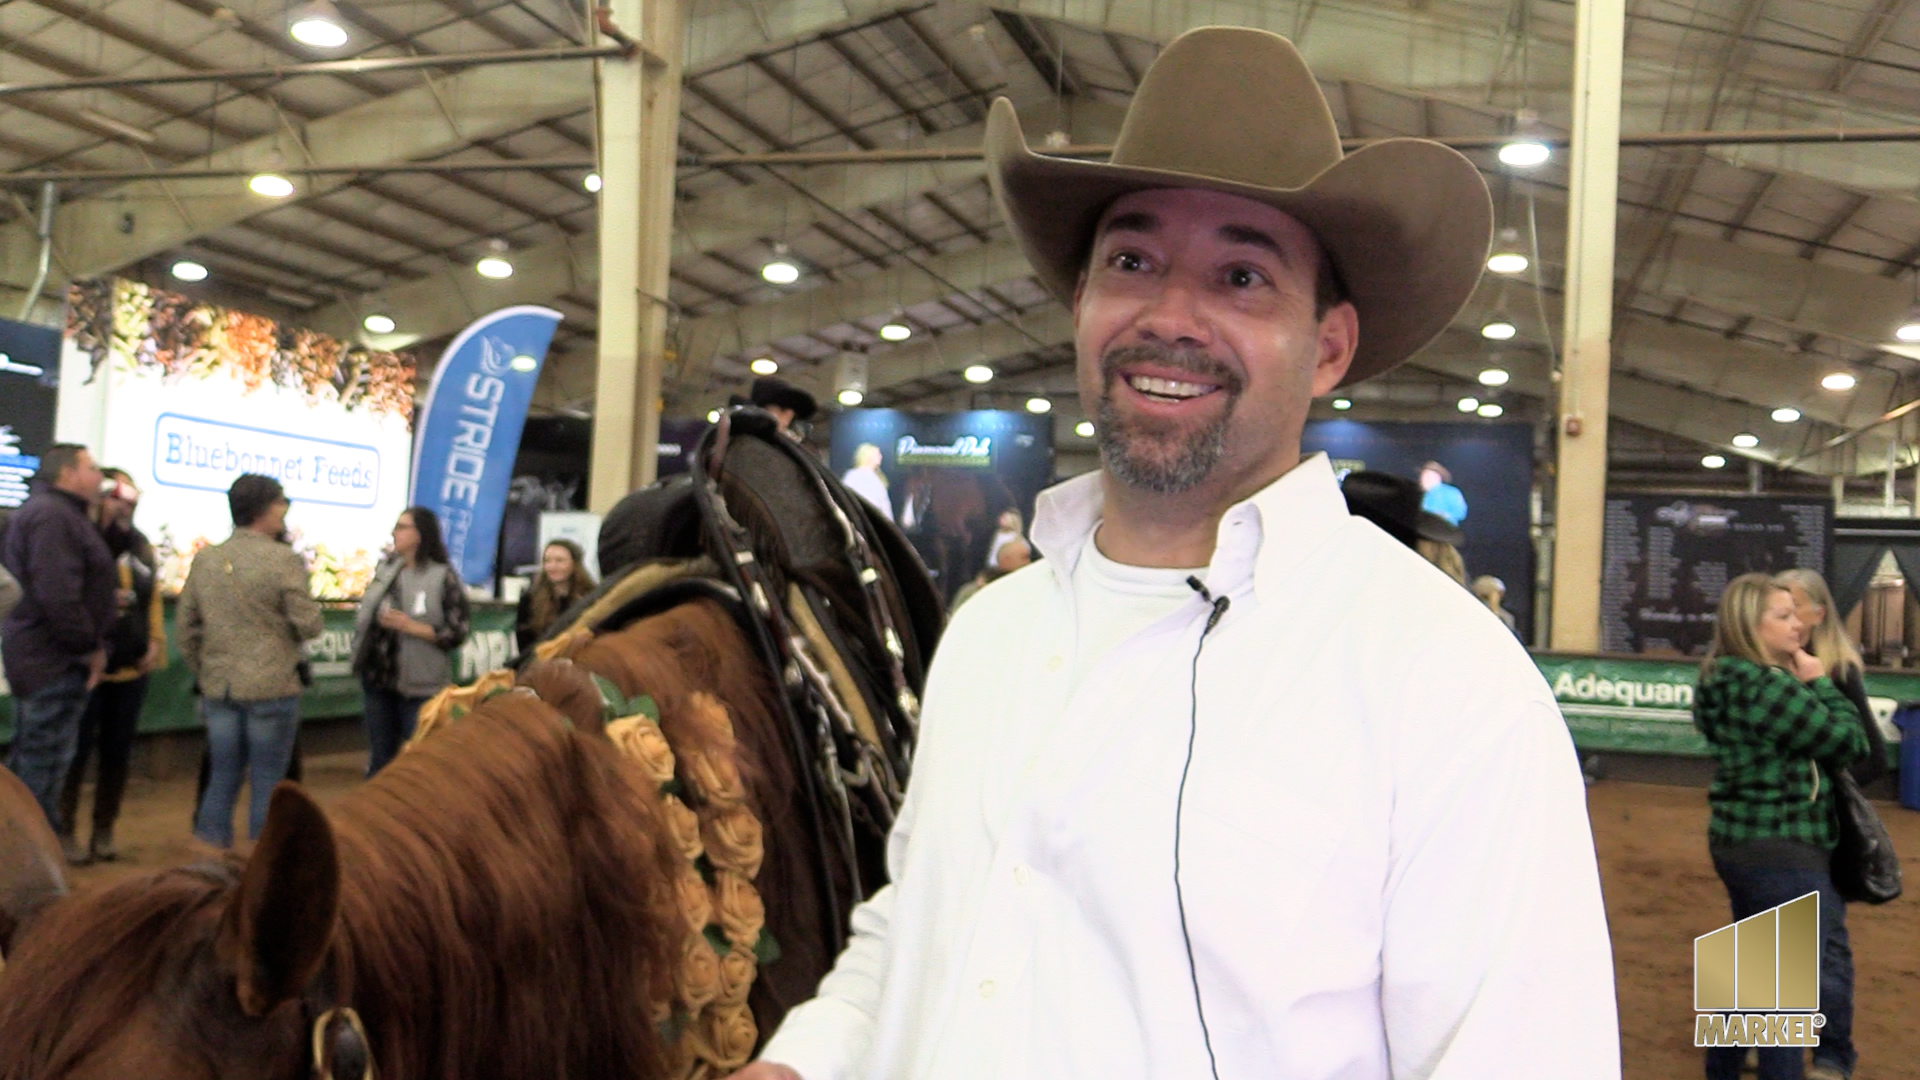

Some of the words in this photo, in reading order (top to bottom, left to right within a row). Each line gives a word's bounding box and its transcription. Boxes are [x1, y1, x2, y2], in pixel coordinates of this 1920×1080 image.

[165, 432, 303, 481] Bluebonnet
[312, 455, 373, 489] Feeds
[440, 373, 505, 507] STRIDE
[1553, 672, 1694, 707] Adequan
